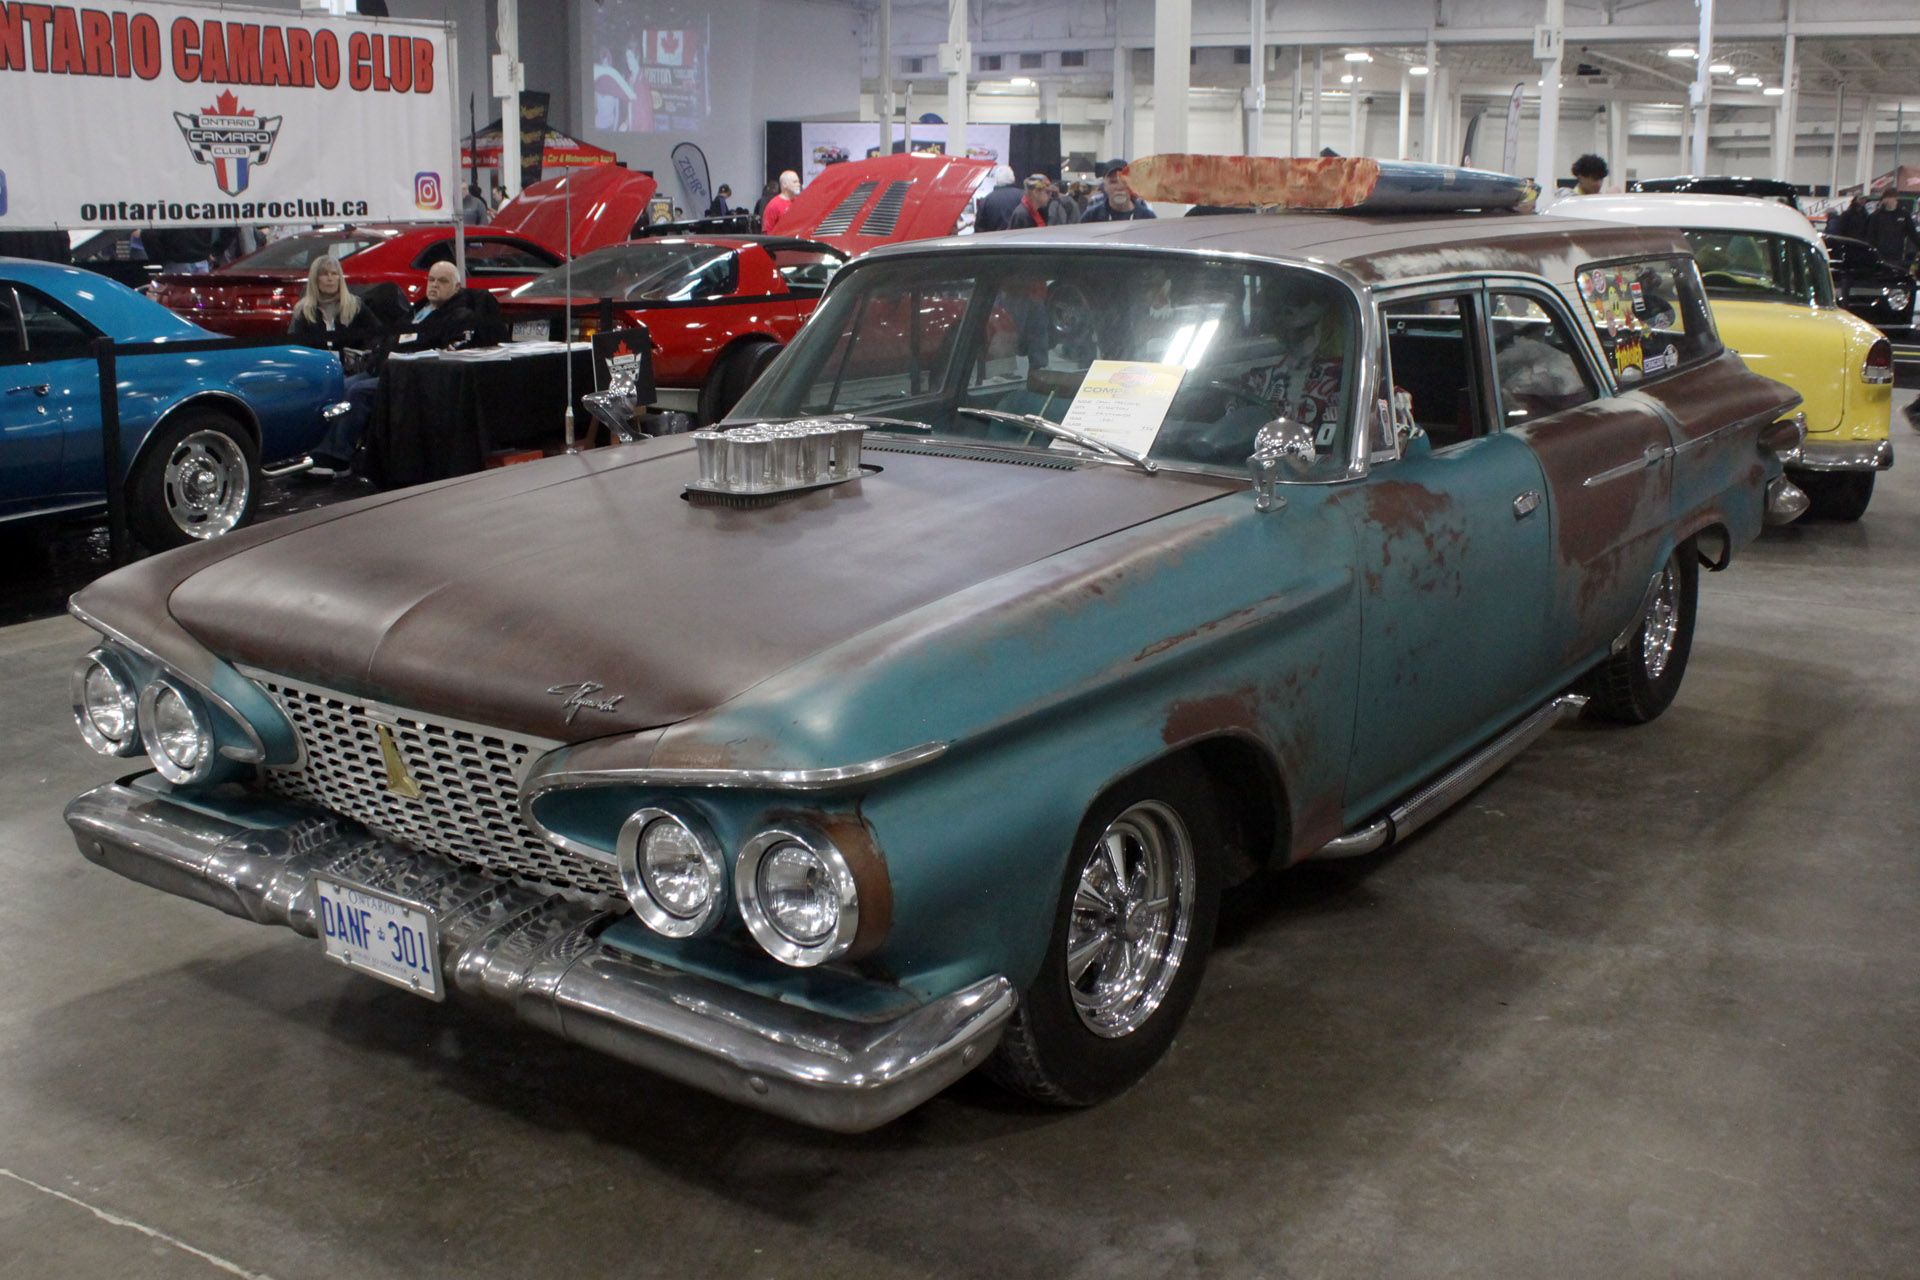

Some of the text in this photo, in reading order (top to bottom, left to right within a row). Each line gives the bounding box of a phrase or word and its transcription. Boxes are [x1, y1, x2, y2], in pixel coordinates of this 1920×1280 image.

[170, 16, 340, 90] CAMARO
[348, 31, 434, 94] CLUB
[201, 117, 256, 127] ONTARIO
[189, 131, 271, 143] CAMARO
[213, 147, 247, 155] CLUB
[79, 198, 369, 222] ontariocamaroclub.ca
[320, 895, 430, 974] DANF 301
